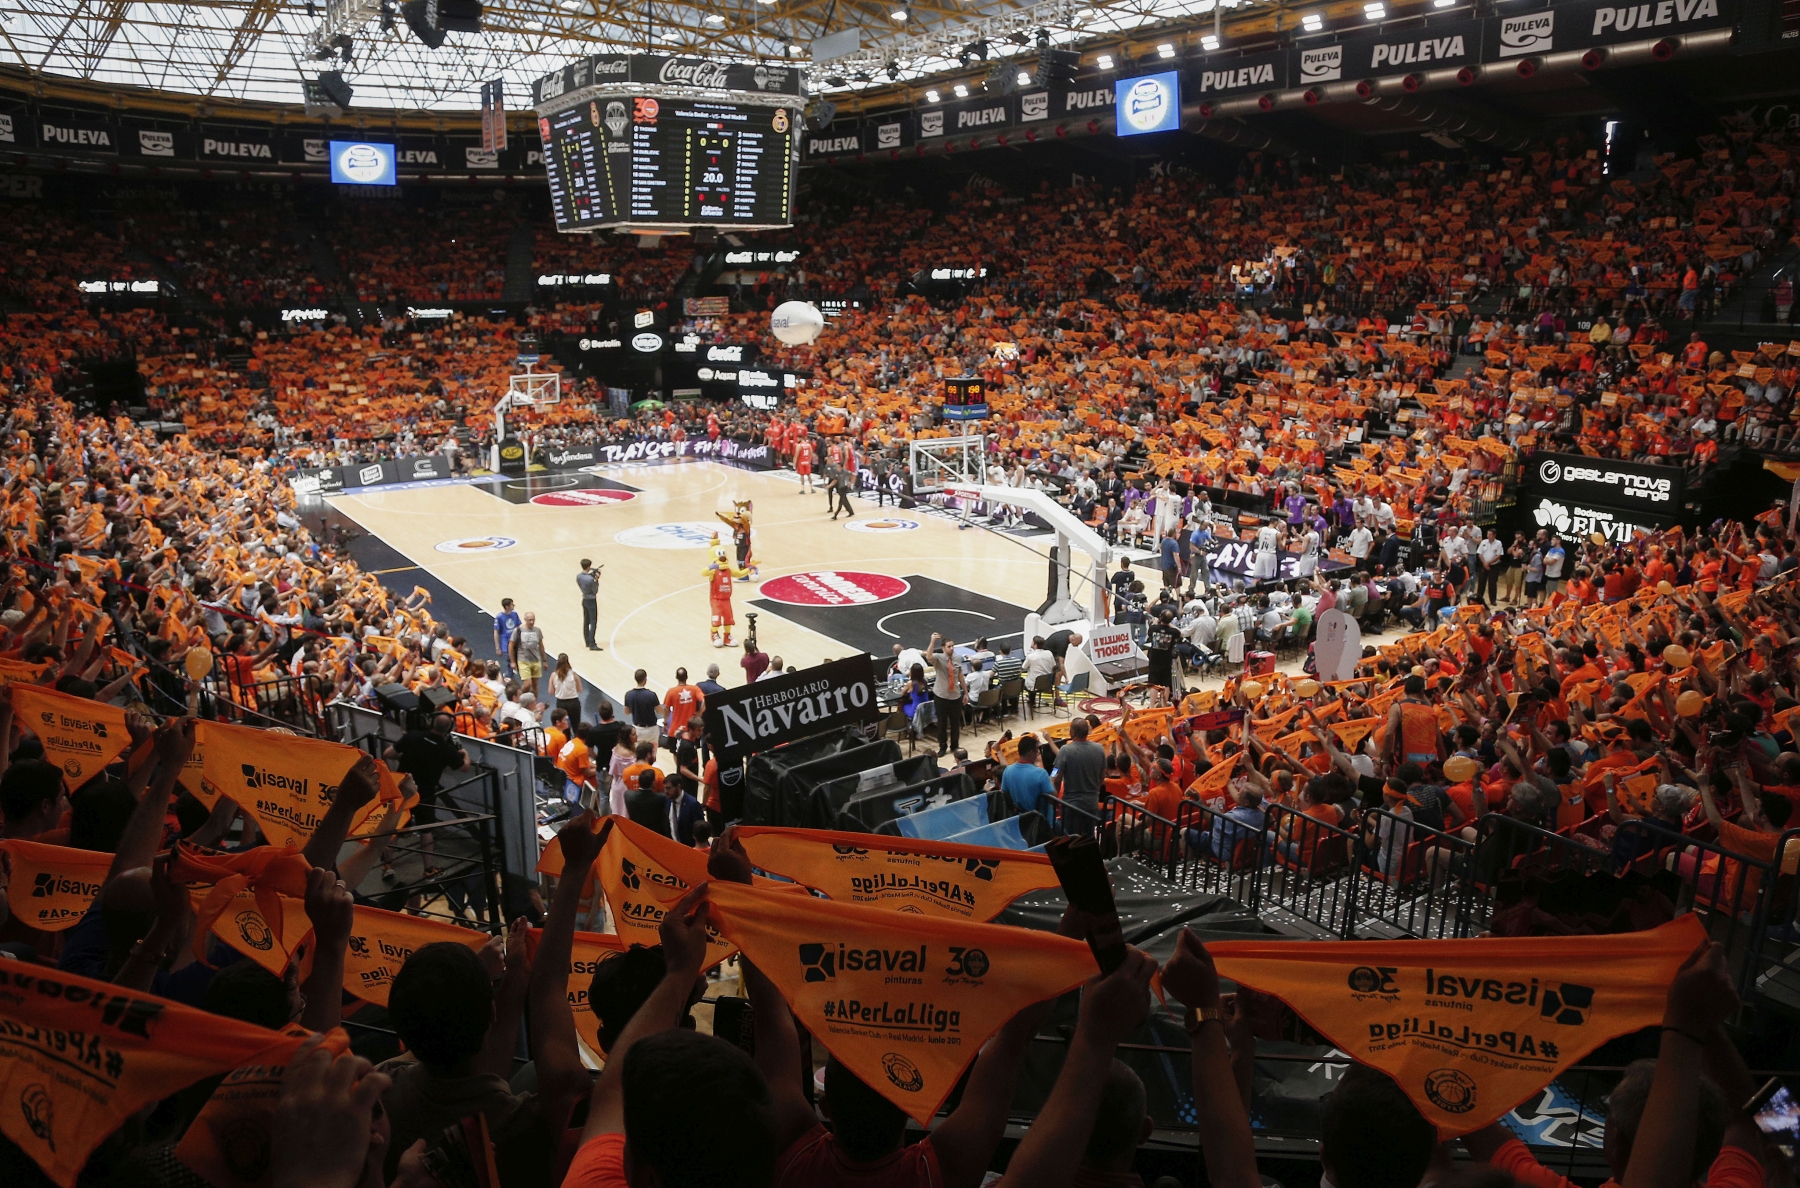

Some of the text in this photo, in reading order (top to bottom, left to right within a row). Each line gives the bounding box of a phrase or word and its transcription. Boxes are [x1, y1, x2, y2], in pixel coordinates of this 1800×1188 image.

[1504, 18, 1550, 34] PULEVA
[1592, 0, 1719, 35] PULEVA
[1303, 51, 1340, 65] PULEVA
[1371, 36, 1465, 68] PULEVA
[595, 60, 628, 75] Coca-Cola
[659, 58, 730, 88] Coca-Cola
[1200, 64, 1275, 92] PULEVA
[1024, 95, 1047, 110] PULEVA
[922, 113, 943, 125] PULEVA
[958, 107, 1006, 128] PULEVA
[43, 124, 110, 147] PULEVA
[142, 134, 172, 144] PULEVA
[880, 126, 900, 138] PULEVA
[203, 138, 272, 159] PULEVA
[809, 136, 859, 154] PULEVA
[703, 172, 724, 183] 20.0
[1577, 321, 1591, 331] 109
[968, 394, 983, 405] 24
[1564, 466, 1671, 492] gesternova
[1574, 507, 1613, 521] Bodegas
[1571, 516, 1596, 536] El
[1099, 633, 1129, 645] FONTETA
[1095, 643, 1130, 659] SOROLL
[754, 679, 830, 709] HERBOLARIO
[717, 682, 869, 748] Navarro
[262, 769, 308, 796] isaval
[56, 875, 100, 896] isava
[717, 939, 729, 948] 2017
[838, 943, 927, 973] isaval
[945, 946, 990, 978] 30
[884, 975, 923, 985] pinturas
[823, 999, 961, 1032] #APerLaLliga
[828, 1025, 850, 1036] Valencia
[850, 1027, 868, 1037] Basket
[868, 1030, 881, 1039] Club
[888, 1032, 902, 1041] Real
[902, 1034, 924, 1043] Madrid
[928, 1036, 945, 1044] Junio
[947, 1037, 961, 1046] 2017
